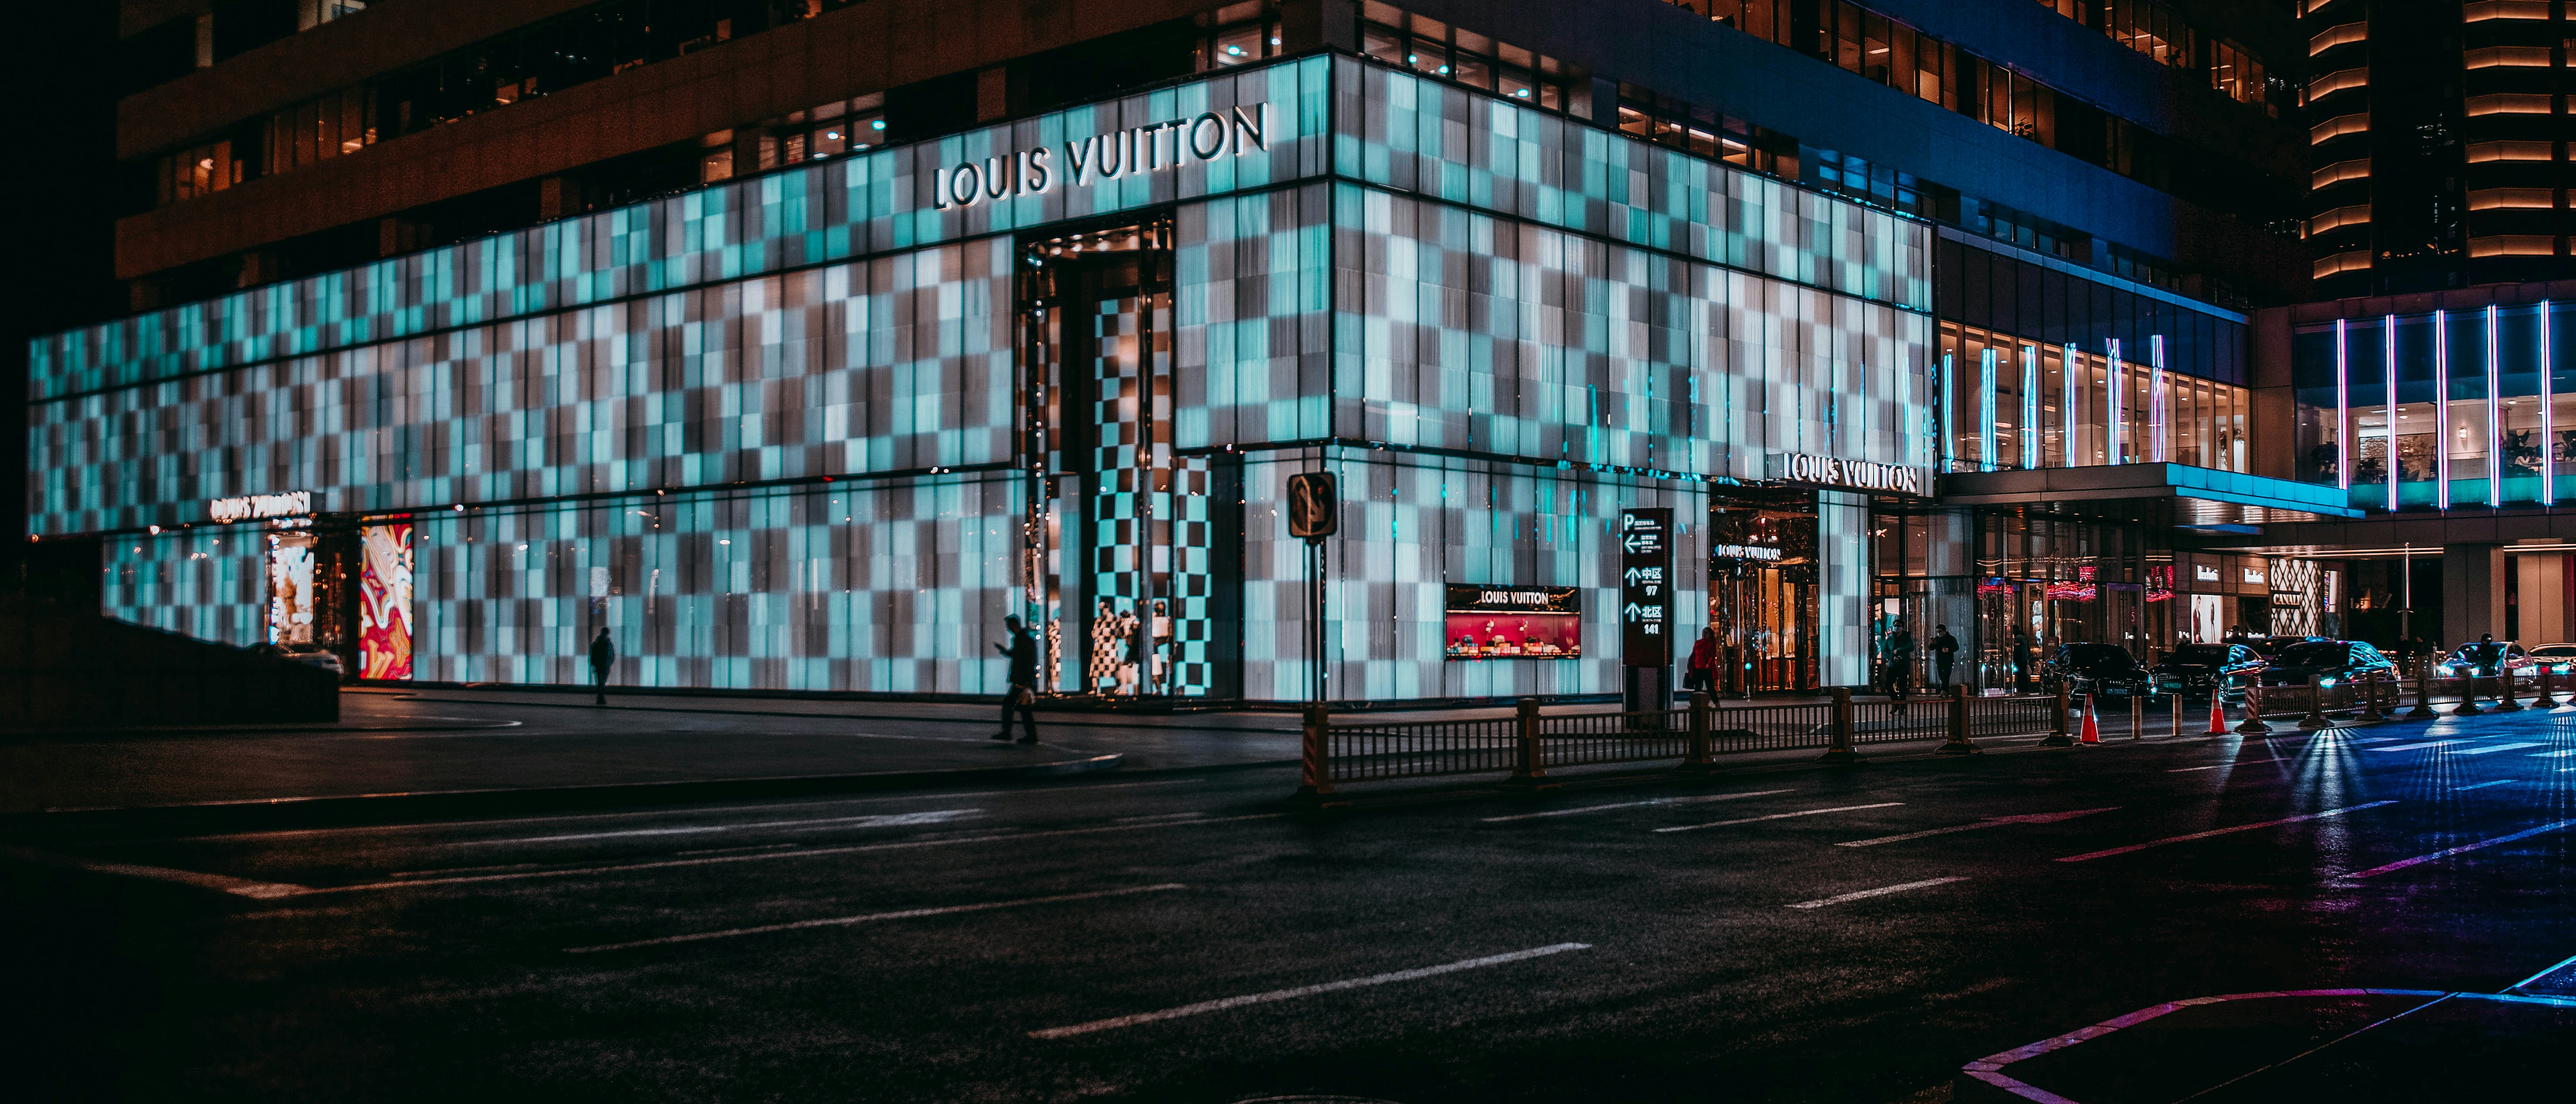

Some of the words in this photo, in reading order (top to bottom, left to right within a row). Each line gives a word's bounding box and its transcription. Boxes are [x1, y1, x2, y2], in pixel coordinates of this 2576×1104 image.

[934, 146, 1053, 212] LOUIS
[1066, 102, 1269, 187] VUITTON
[1783, 452, 1840, 484] LOUIS
[1842, 460, 1917, 492] VUITTON
[1624, 515, 1634, 530] P
[1642, 567, 1662, 579] 中区
[1646, 586, 1657, 596] 97
[1481, 591, 1508, 604] LOUIS
[1510, 592, 1549, 605] VUITTON
[2273, 593, 2301, 605] CANALI
[1642, 606, 1662, 618] 北区
[1644, 624, 1658, 634] 141
